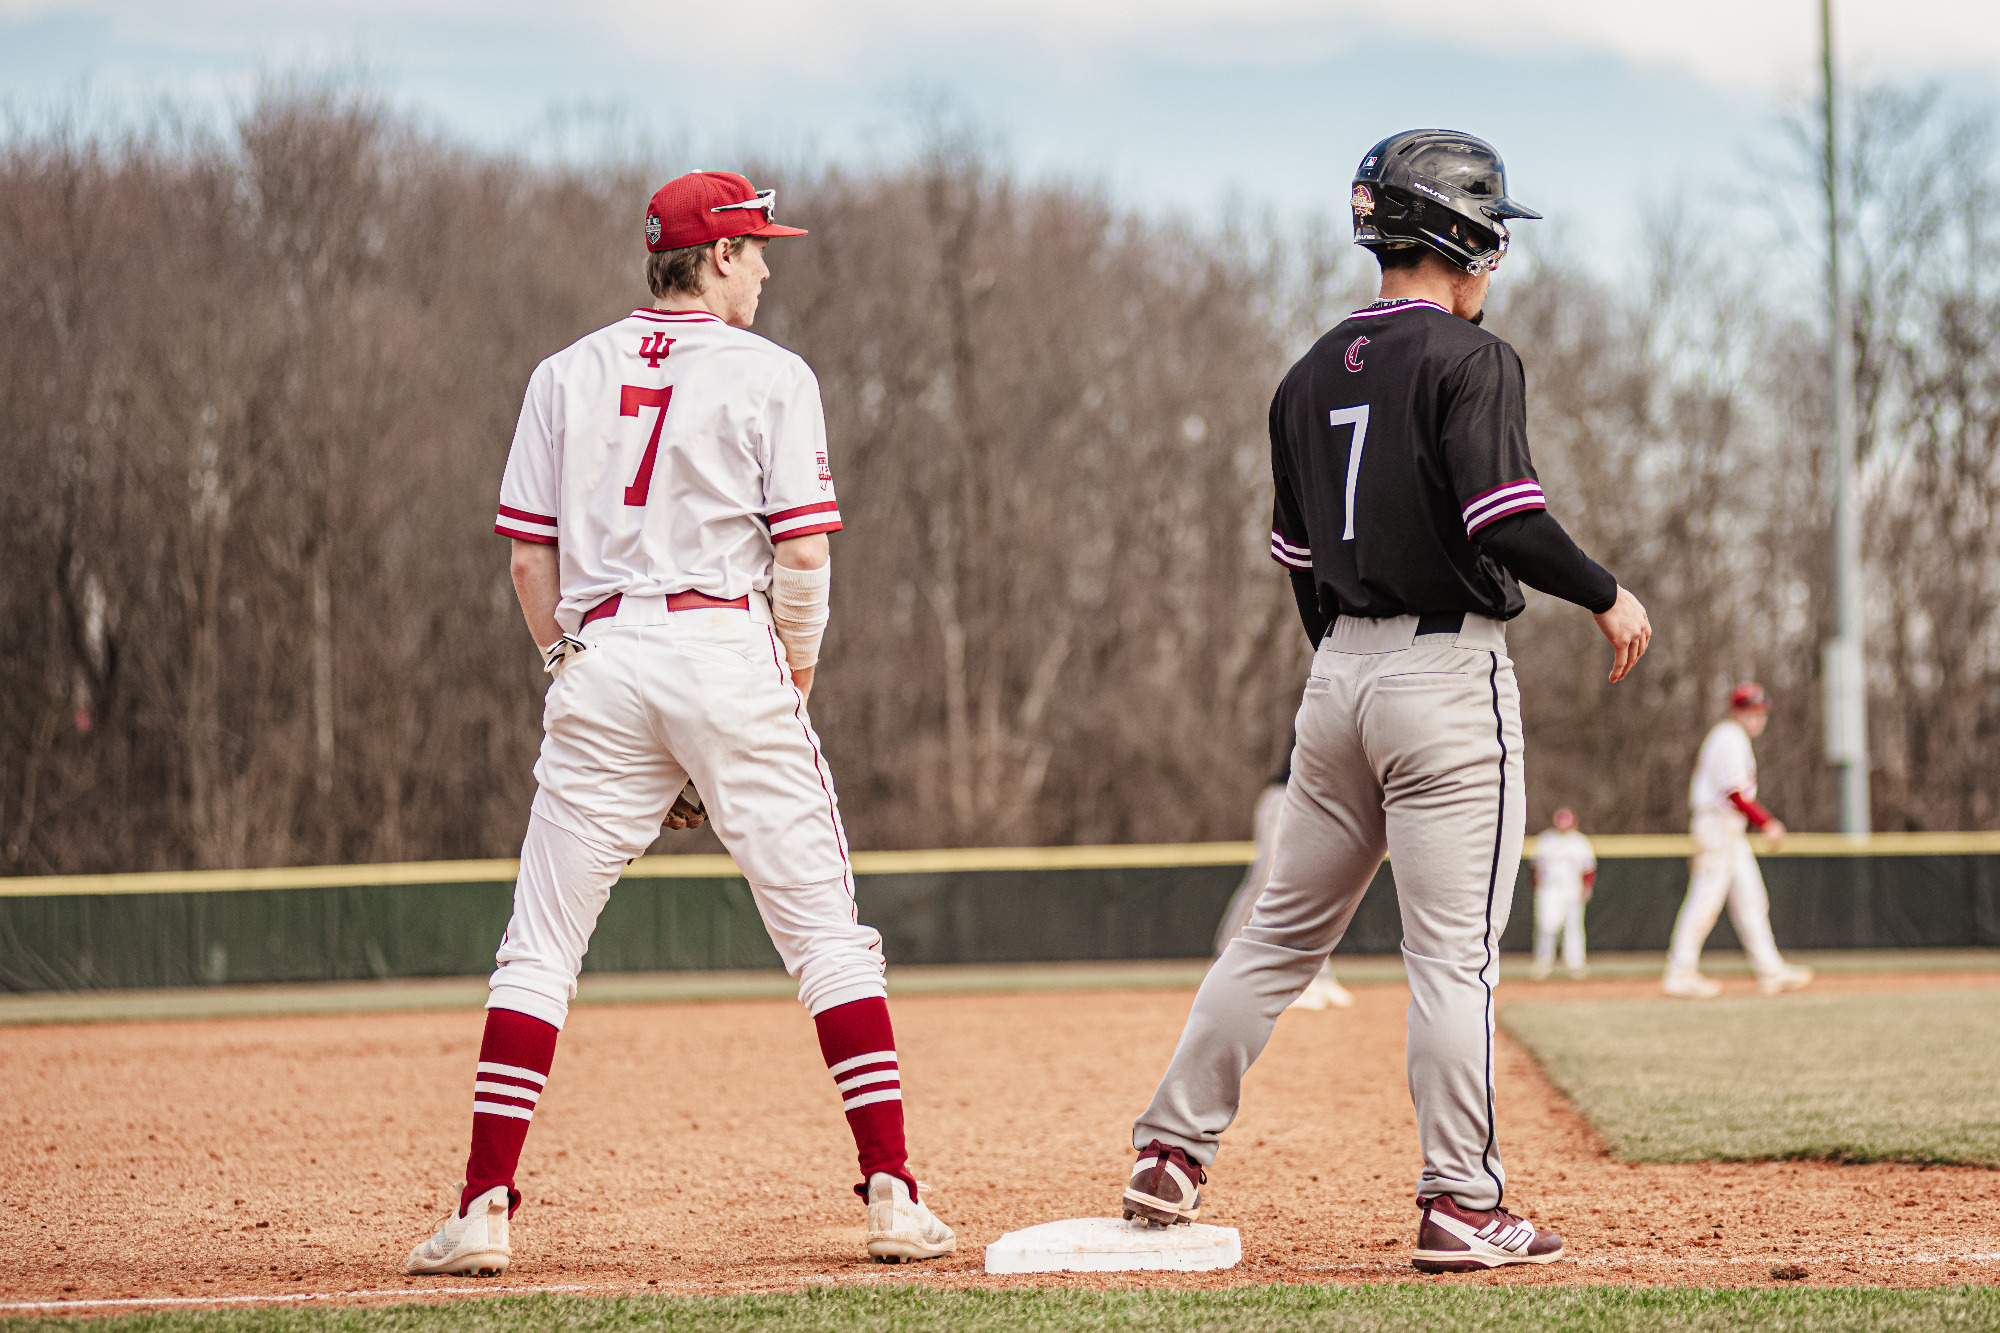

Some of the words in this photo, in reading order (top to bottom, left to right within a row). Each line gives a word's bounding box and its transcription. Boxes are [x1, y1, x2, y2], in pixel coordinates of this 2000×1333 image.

[1344, 335, 1371, 373] C
[619, 384, 674, 507] 7
[1329, 403, 1371, 541] 7
